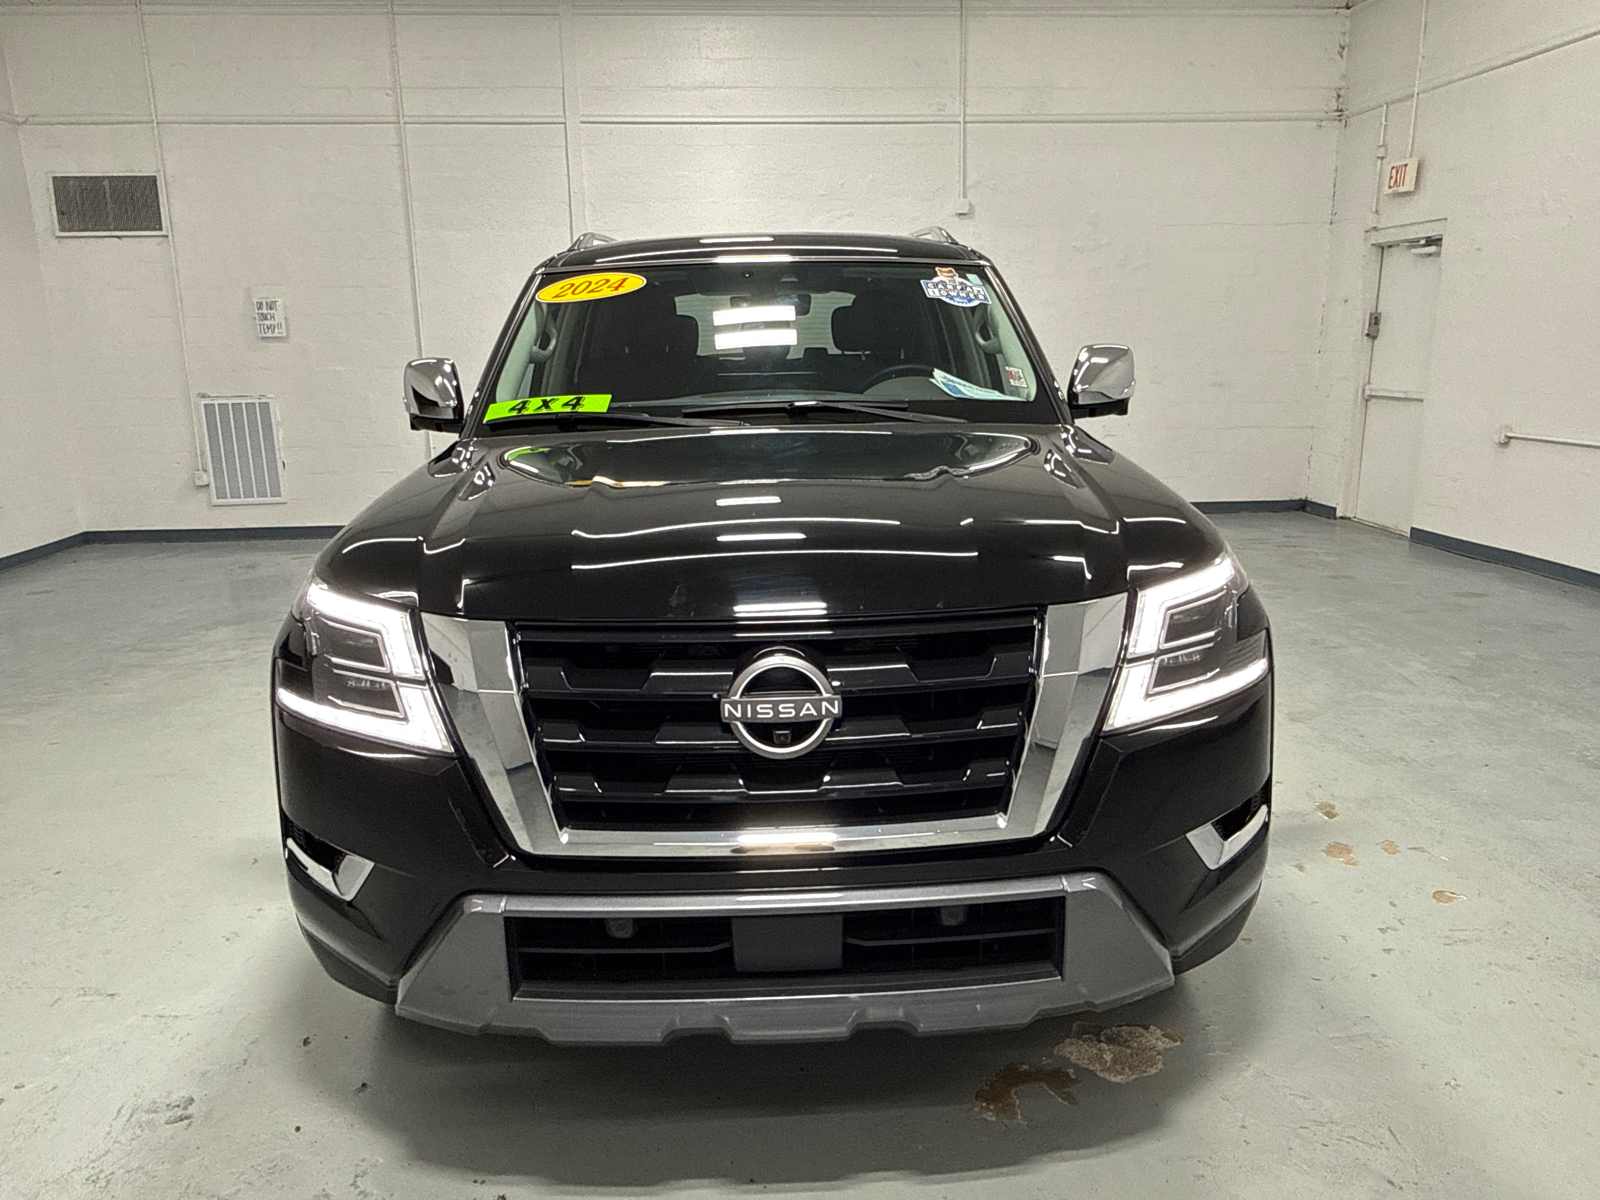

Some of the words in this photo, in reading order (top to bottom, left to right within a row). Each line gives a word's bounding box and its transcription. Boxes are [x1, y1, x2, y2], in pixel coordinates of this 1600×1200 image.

[1388, 163, 1408, 189] EXIT
[551, 277, 630, 299] 2024
[927, 282, 985, 295] CARFAX
[256, 301, 263, 311] DO
[266, 300, 278, 311] NOT
[257, 312, 275, 322] TOUCH
[258, 322, 283, 334] TEMP!!
[724, 700, 839, 718] NISSAN
